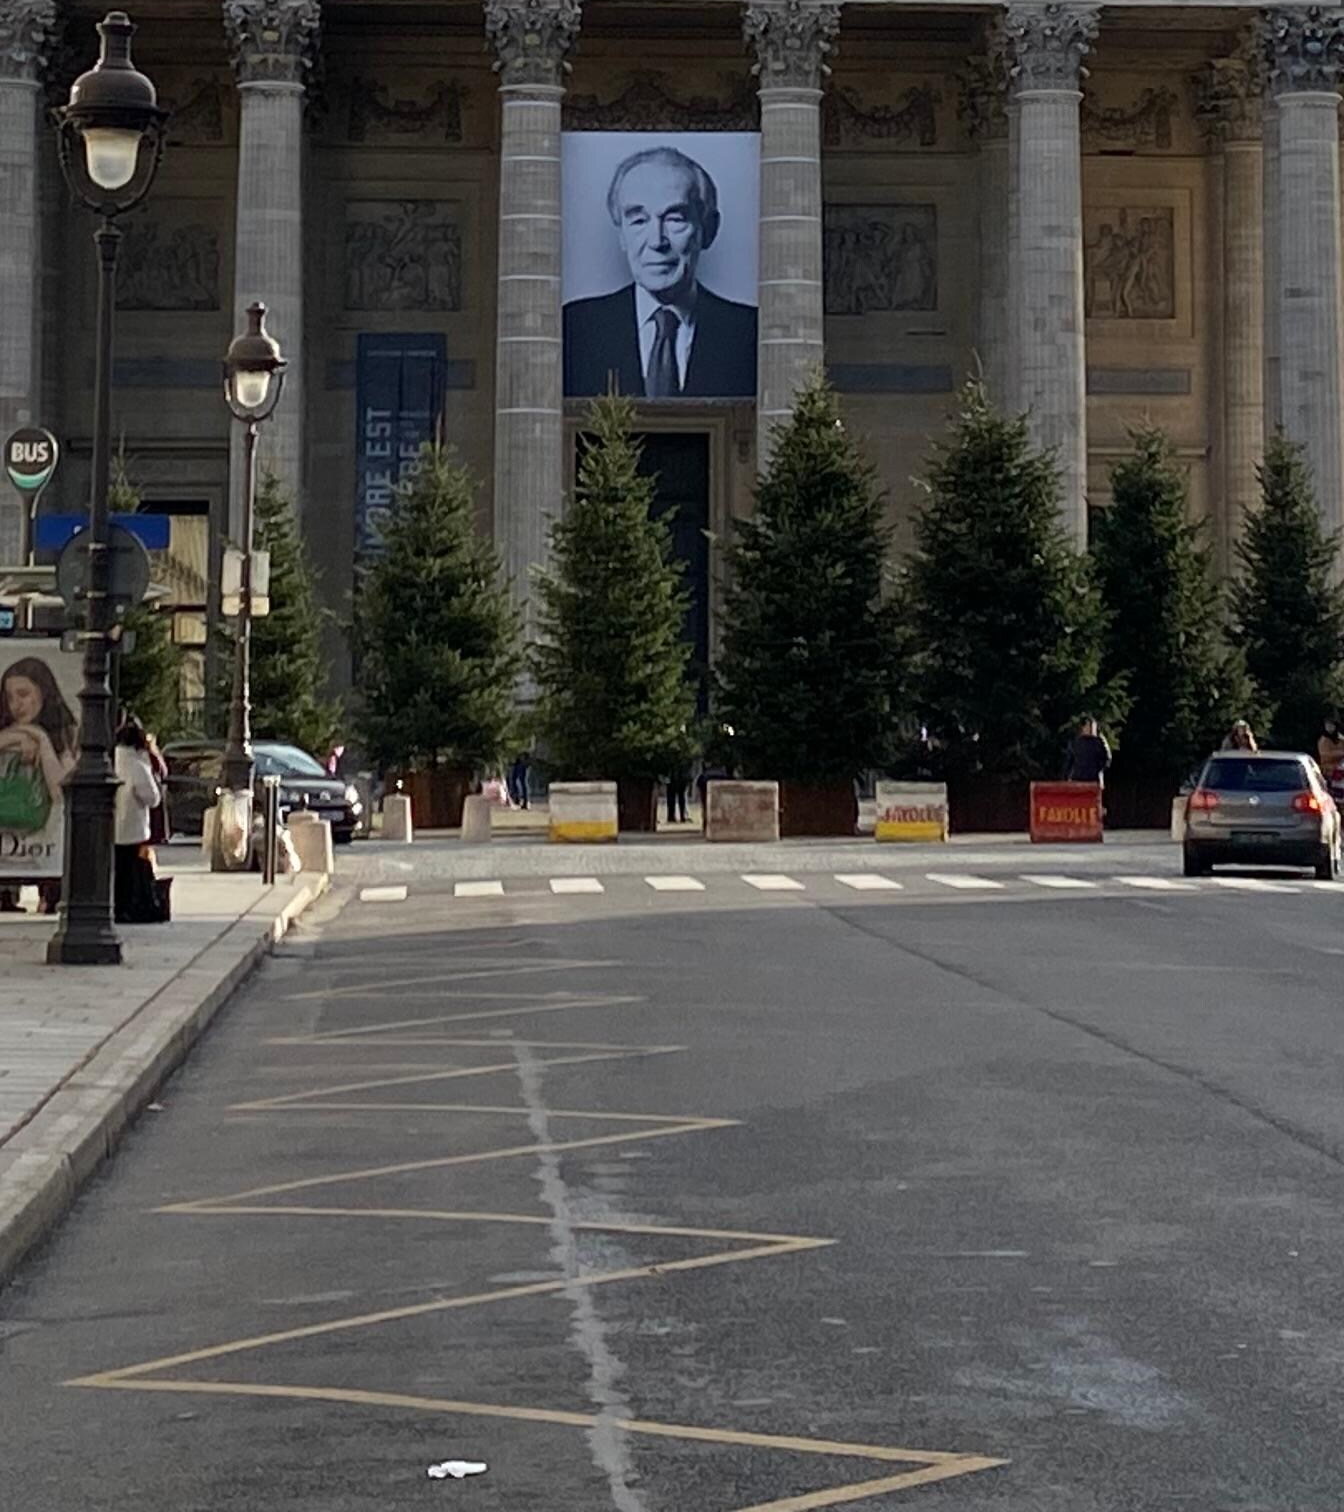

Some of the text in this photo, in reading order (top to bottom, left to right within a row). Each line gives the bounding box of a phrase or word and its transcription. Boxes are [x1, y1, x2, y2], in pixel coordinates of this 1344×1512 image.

[366, 407, 391, 457] EST
[11, 442, 49, 462] BUS
[1040, 807, 1097, 825] FAYOLLE
